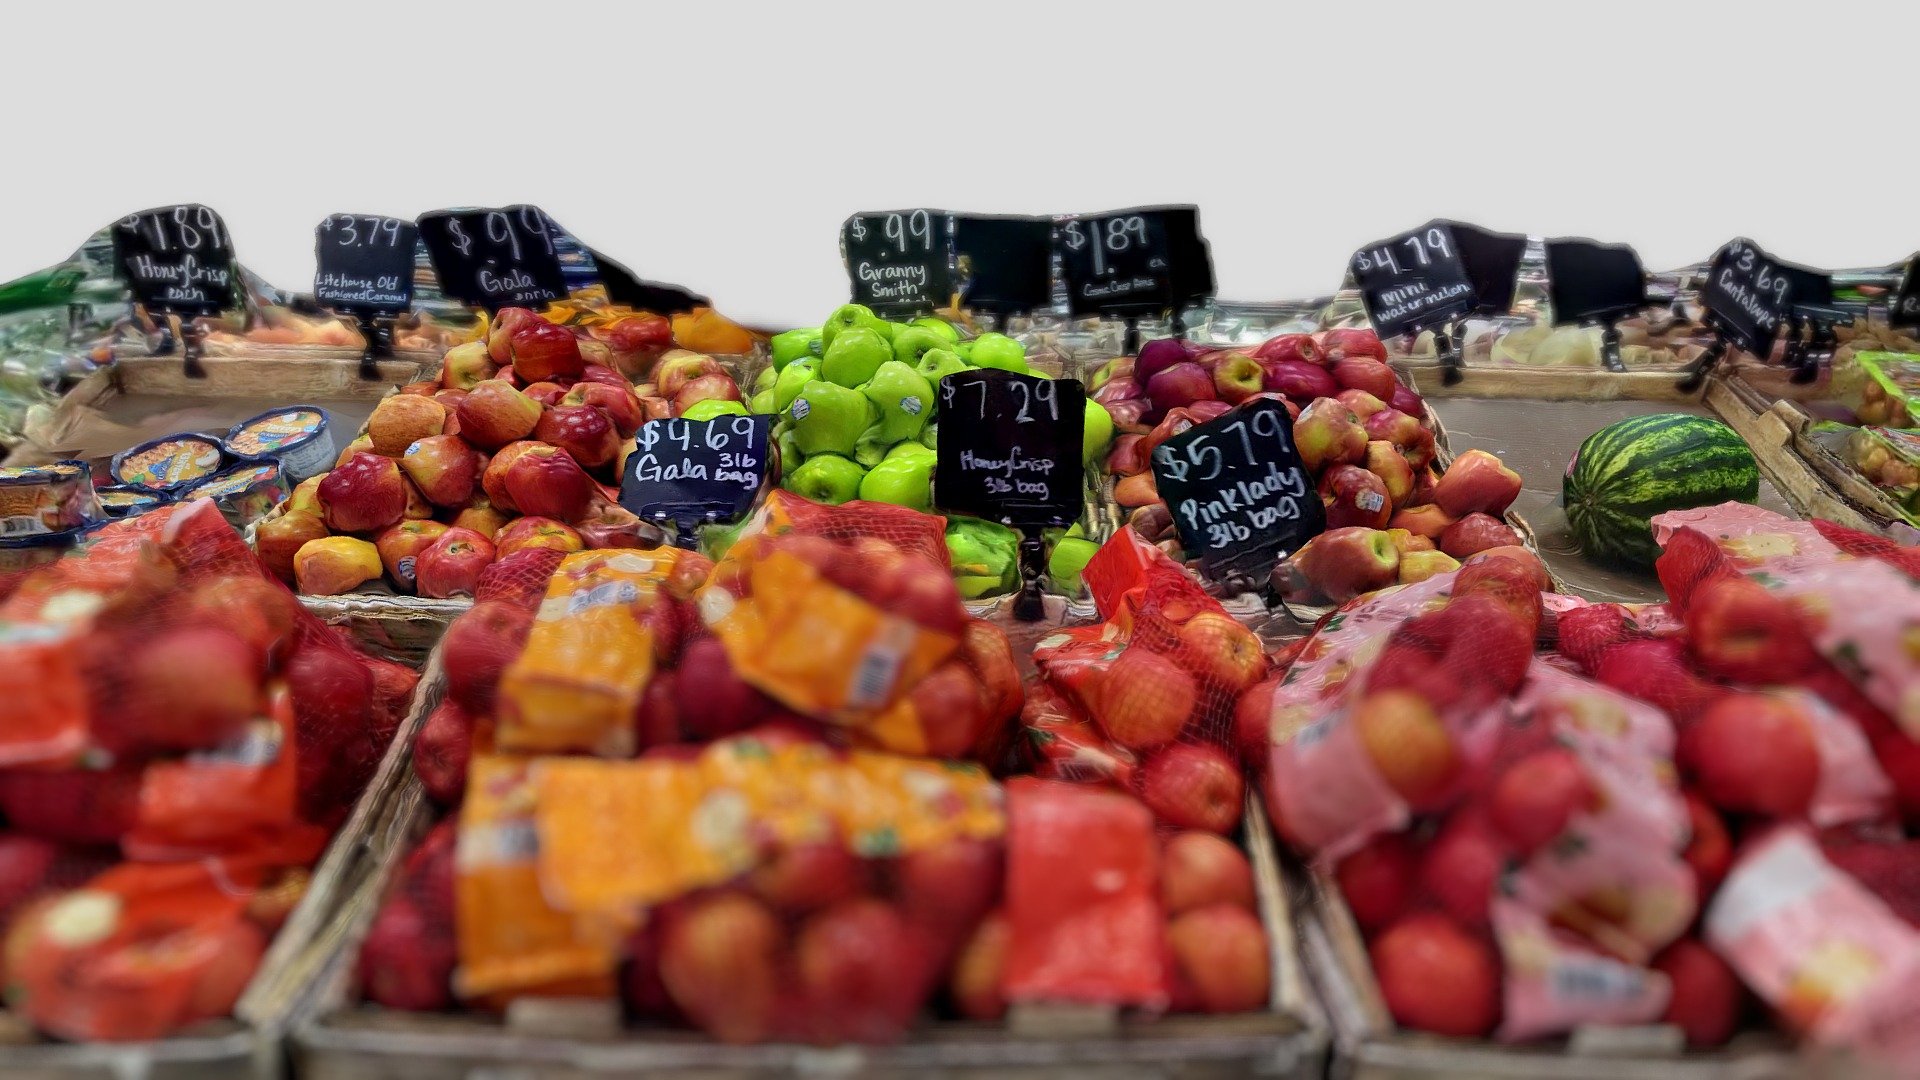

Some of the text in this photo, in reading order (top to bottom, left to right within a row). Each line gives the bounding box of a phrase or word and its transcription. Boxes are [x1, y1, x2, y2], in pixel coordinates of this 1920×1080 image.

[323, 215, 401, 247] $3.79
[852, 209, 930, 257] $.99
[1065, 216, 1147, 275] $1.89
[1357, 228, 1453, 275] $4.79
[315, 272, 399, 291] Litehouse Old
[480, 269, 536, 293] Gala
[859, 261, 926, 286] Granny
[871, 279, 918, 298] Smith
[940, 376, 1059, 424] $7.29
[636, 417, 755, 452] $4.69
[1158, 410, 1291, 483] $5.79
[635, 452, 757, 483] Gala 3lb
[713, 467, 759, 490] bag
[1015, 478, 1050, 501] bag
[1206, 496, 1301, 549] 3lb bag
